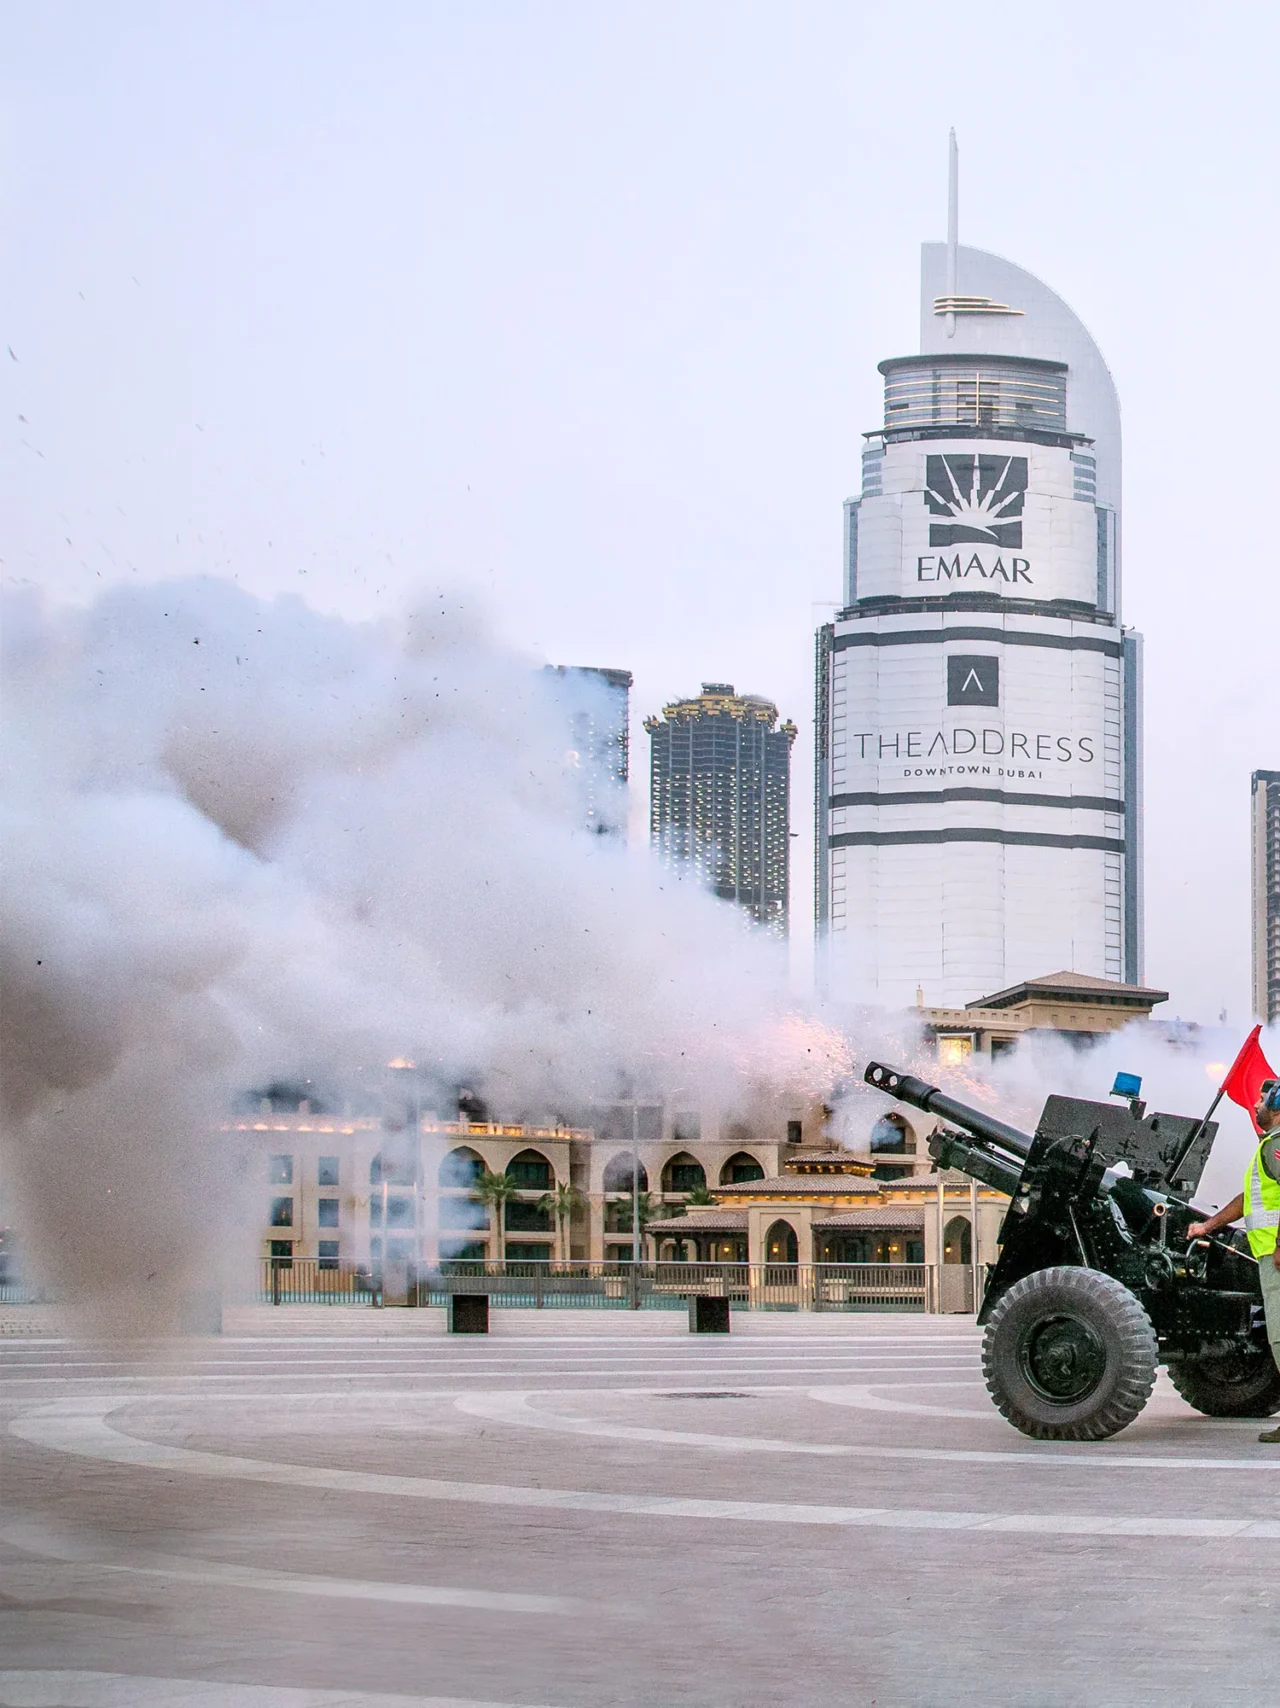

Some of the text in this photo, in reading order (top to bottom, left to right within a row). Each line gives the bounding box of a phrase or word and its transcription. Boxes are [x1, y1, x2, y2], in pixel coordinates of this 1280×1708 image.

[917, 552, 1034, 584] EMAAR
[903, 765, 1042, 779] DOWNTOWN DUBAI
